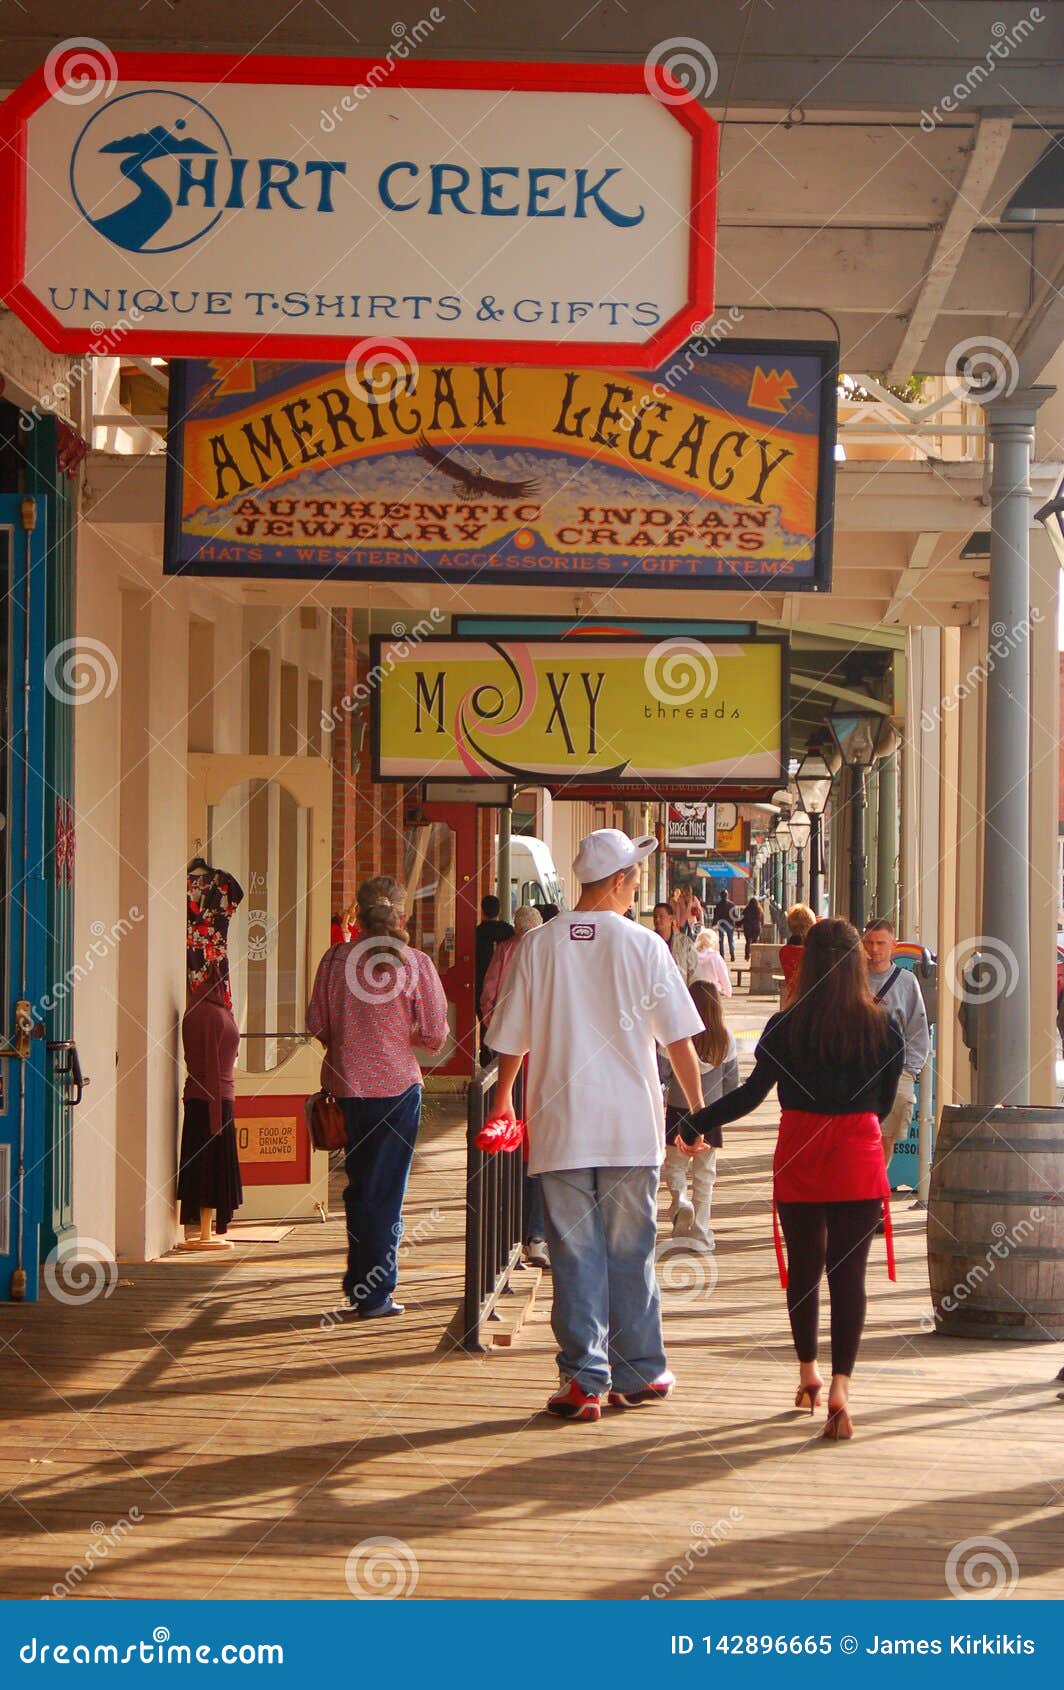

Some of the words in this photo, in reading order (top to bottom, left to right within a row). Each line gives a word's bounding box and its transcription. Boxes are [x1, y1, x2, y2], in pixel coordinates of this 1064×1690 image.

[378, 161, 645, 228] CREEK
[48, 286, 232, 316] UNIQUE
[475, 295, 504, 322] &
[512, 298, 661, 327] GIFTS
[207, 365, 507, 499] AMERICAN
[552, 371, 793, 504] LEGACY
[232, 499, 543, 523] AUTHENTIC
[577, 505, 773, 529] INDIAN
[235, 518, 487, 542] JEWELRY
[555, 527, 766, 551] CRAFTS
[200, 547, 263, 562] HATS
[296, 548, 419, 566] WESTERN
[438, 552, 611, 571] ACCESSORIES
[641, 558, 702, 574] GIFT
[717, 559, 796, 575] ITEMS
[414, 671, 606, 755] MOXY
[643, 703, 742, 720] threads
[258, 1127, 280, 1137] FOOD
[281, 1126, 293, 1136] OR
[258, 1136, 289, 1147] DRINKS
[259, 1144, 293, 1155] ALLOWED
